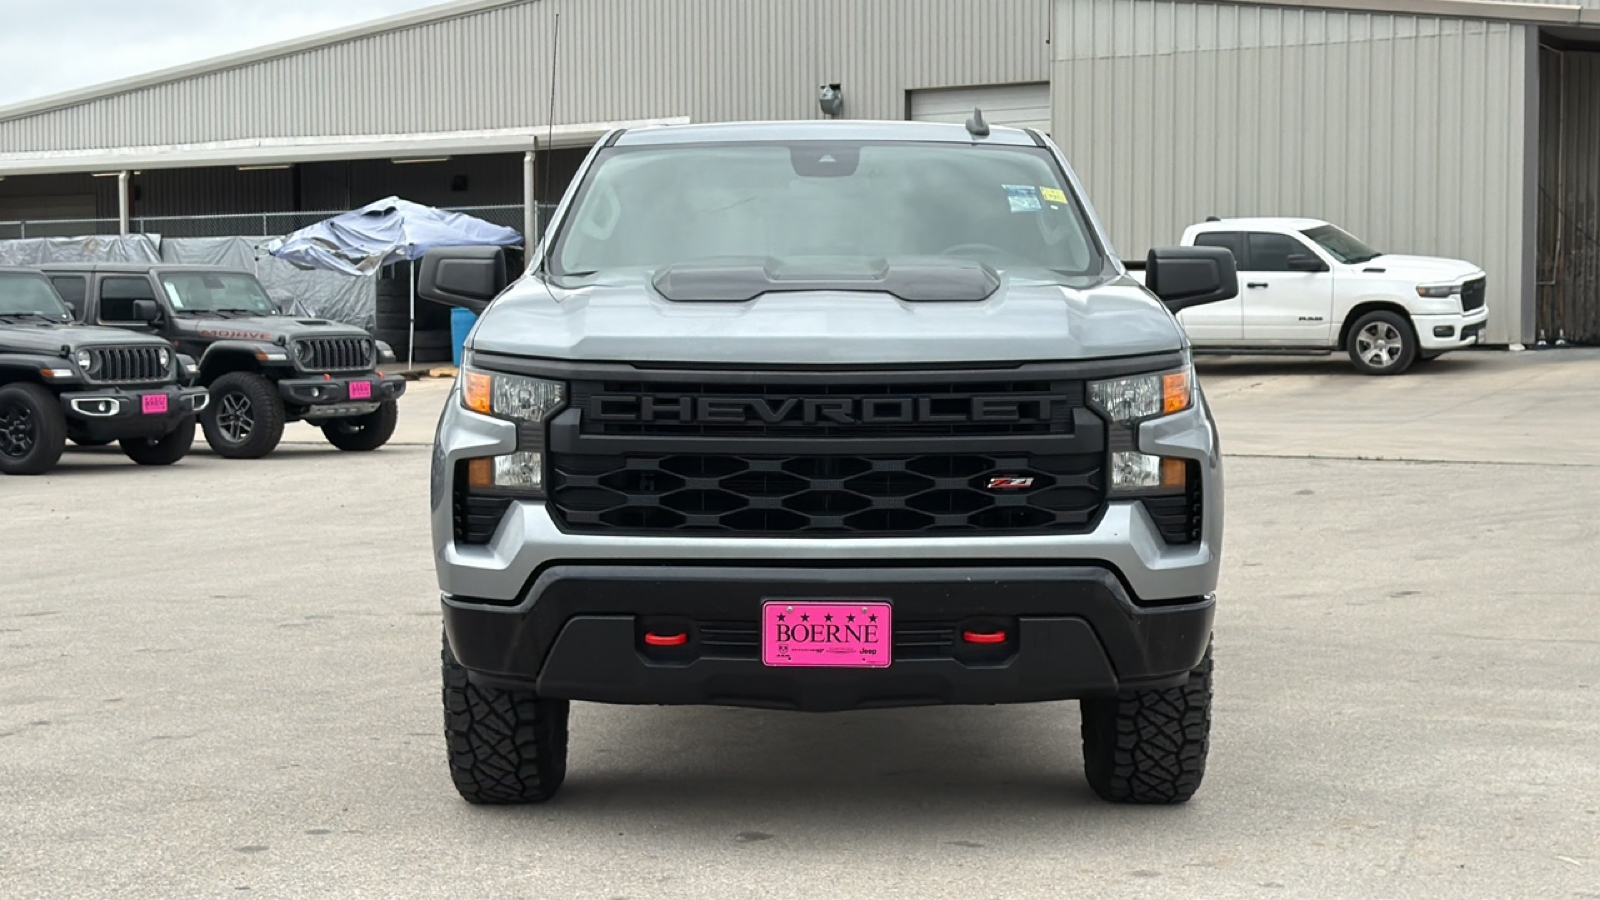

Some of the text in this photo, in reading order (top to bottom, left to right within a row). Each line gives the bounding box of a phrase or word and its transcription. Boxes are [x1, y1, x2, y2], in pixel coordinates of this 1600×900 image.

[199, 330, 270, 340] MOJAVE
[589, 395, 1067, 423] CHEVROLET
[987, 477, 1034, 488] Z71
[776, 624, 879, 643] BOERNE
